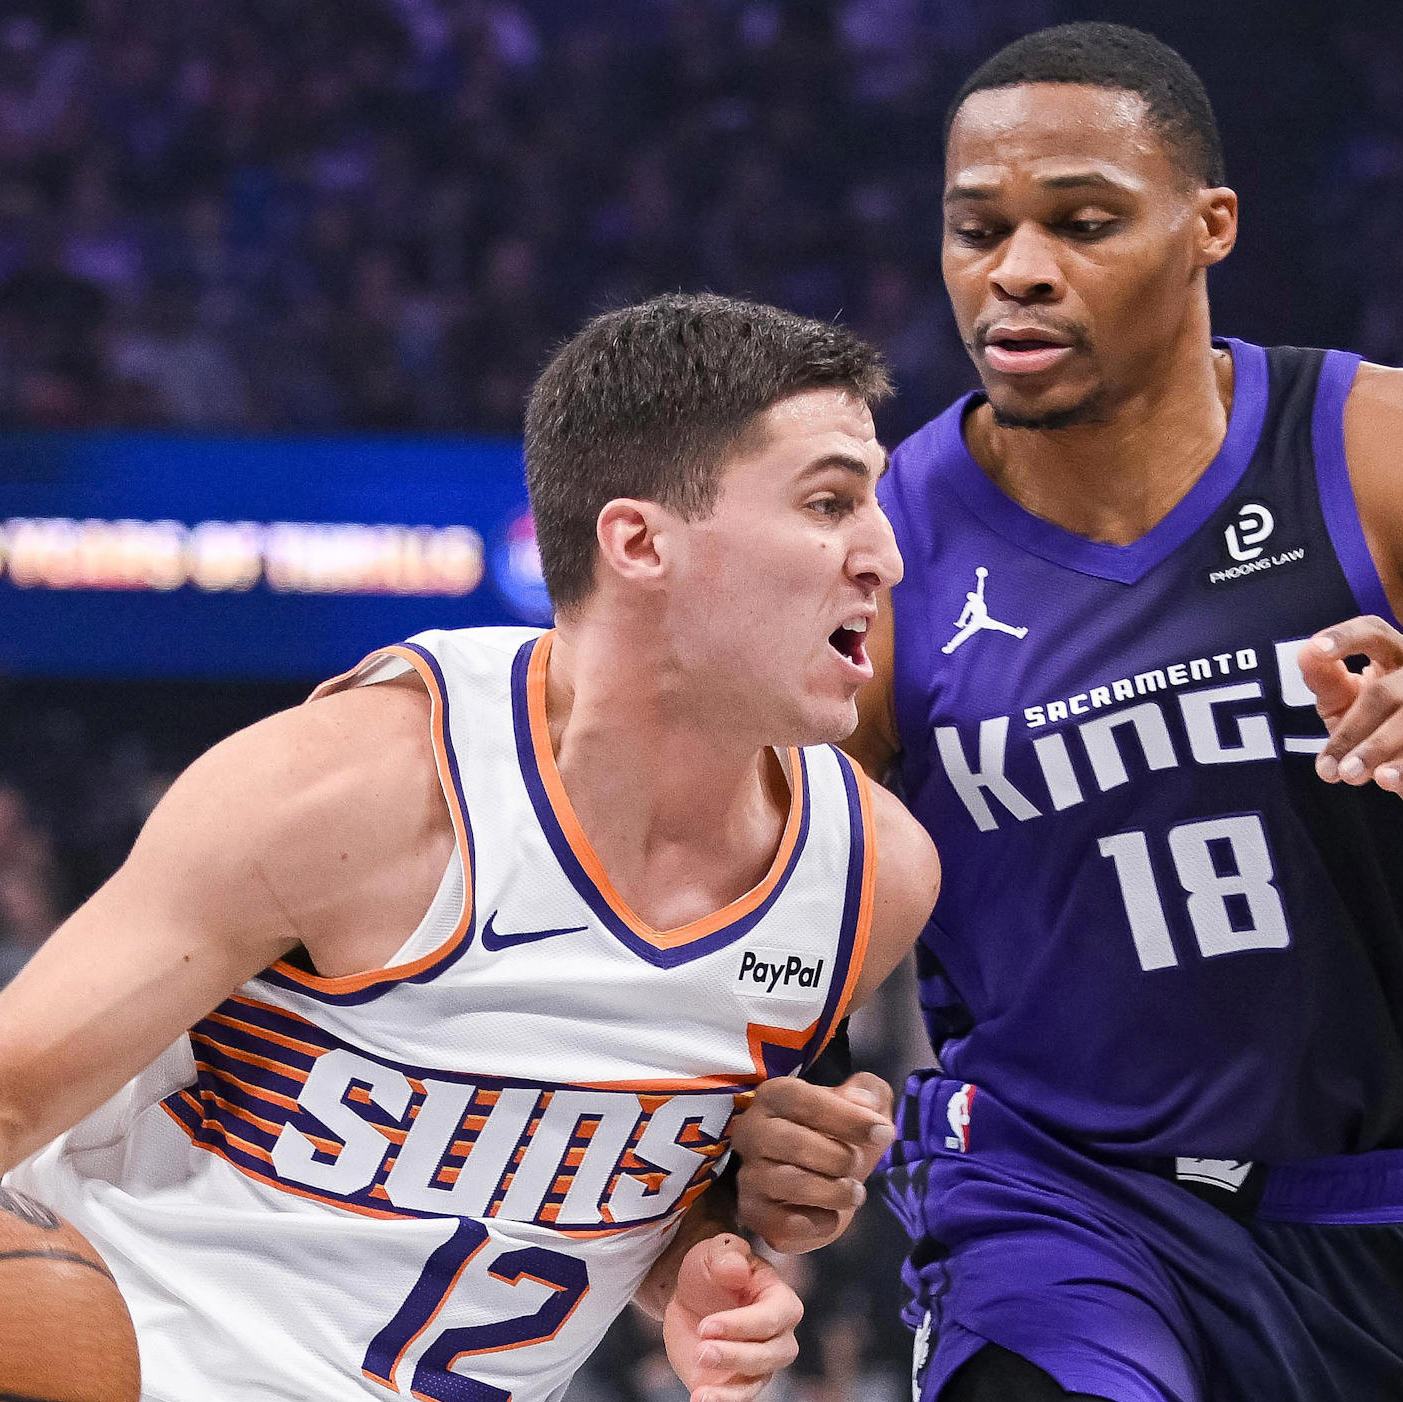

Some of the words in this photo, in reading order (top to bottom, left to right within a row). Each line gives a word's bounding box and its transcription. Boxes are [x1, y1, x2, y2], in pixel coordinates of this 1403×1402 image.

[1209, 558, 1271, 584] PHOONG
[1271, 547, 1305, 566] LAW
[1023, 648, 1258, 729] SACRAMENTO
[1098, 810, 1292, 972] 18
[738, 951, 824, 993] PayPal
[270, 1046, 736, 1226] SUNS
